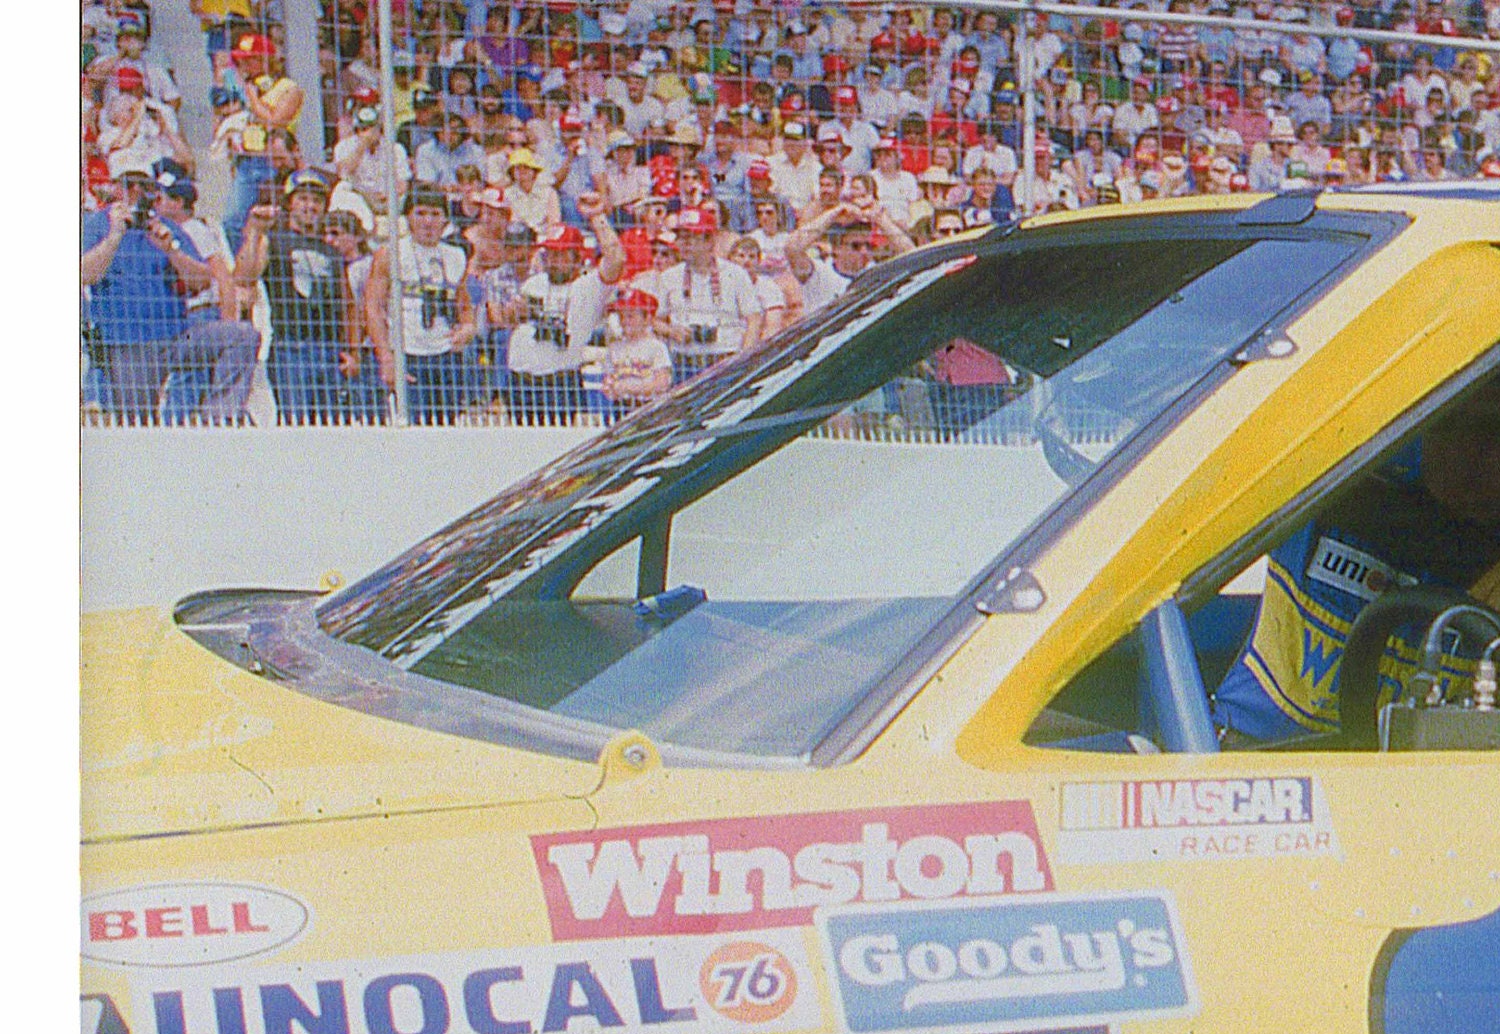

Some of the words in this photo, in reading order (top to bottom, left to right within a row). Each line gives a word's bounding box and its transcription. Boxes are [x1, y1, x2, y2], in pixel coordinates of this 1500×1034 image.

[1141, 778, 1308, 827] NASCAR
[1180, 833, 1260, 856] RACE
[1274, 831, 1331, 852] CAR
[548, 822, 1047, 920] Winston
[88, 901, 270, 943] BELL
[709, 957, 789, 1006] 76
[840, 918, 1174, 1006] Goody's
